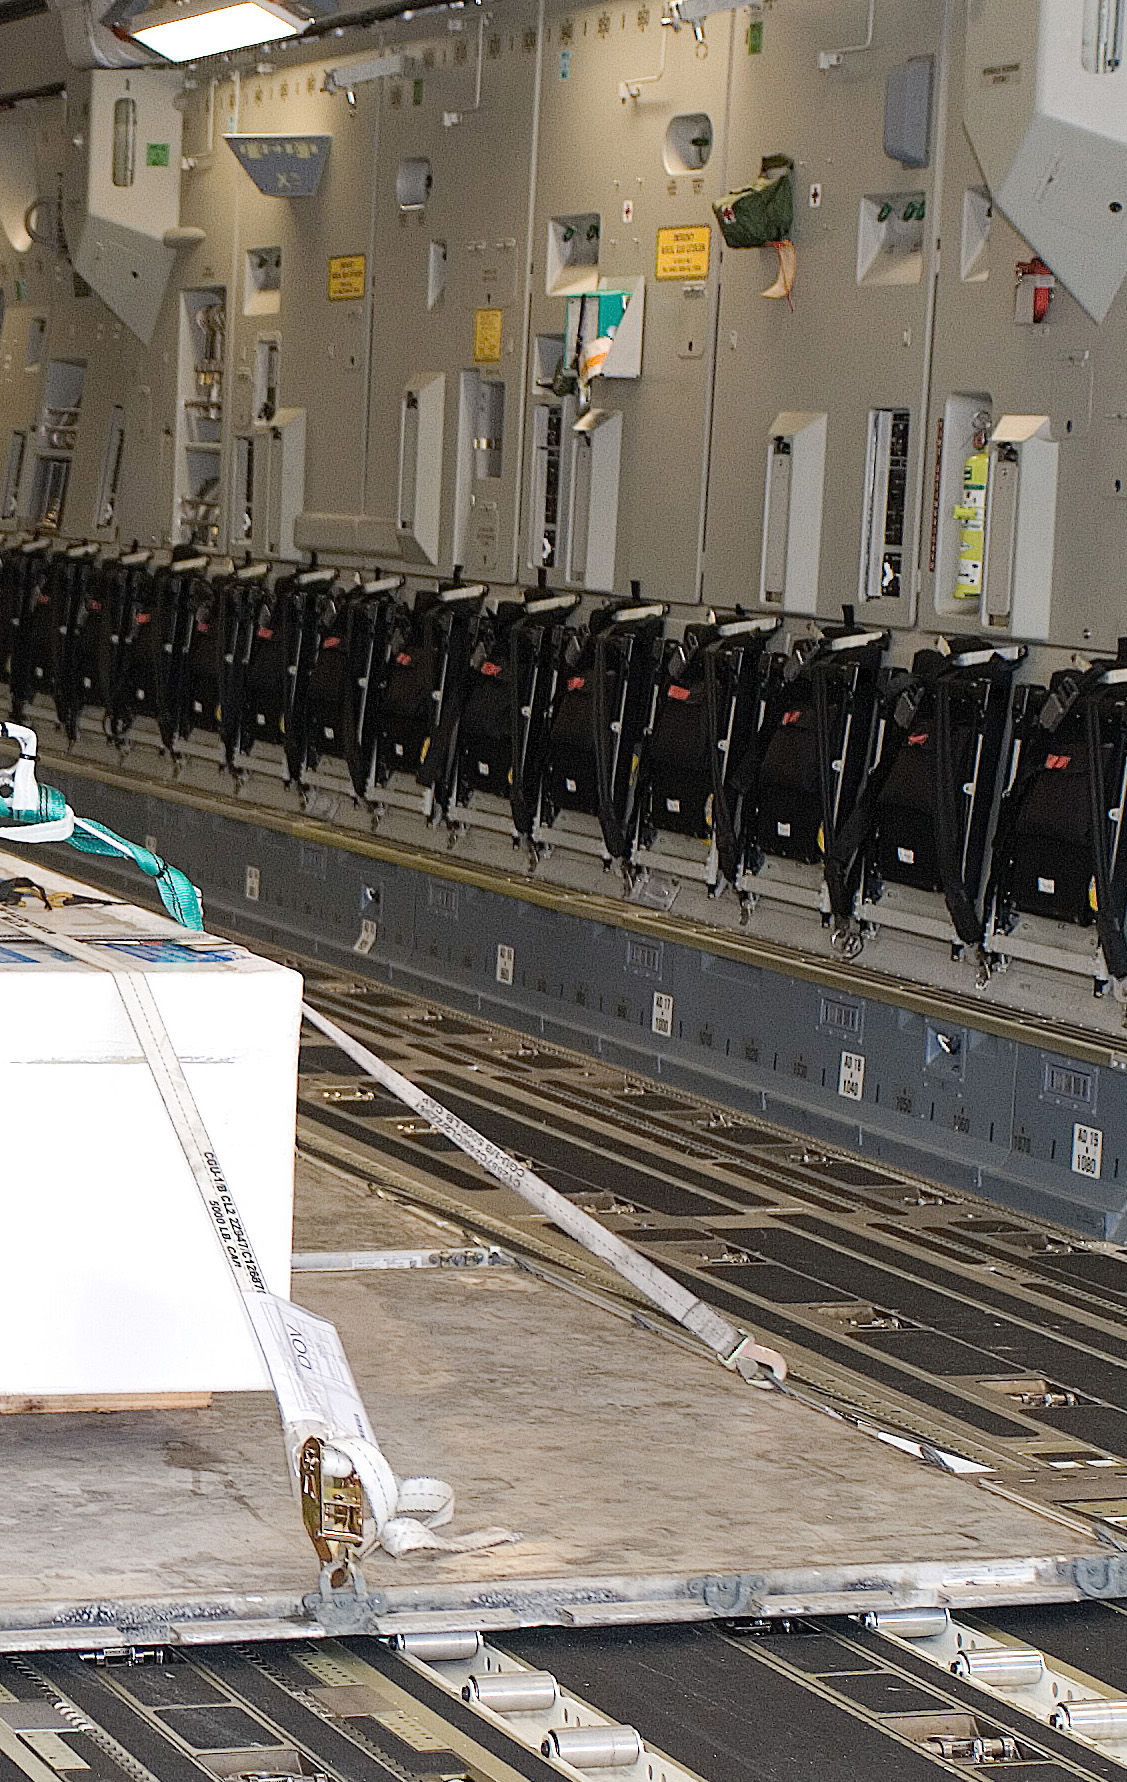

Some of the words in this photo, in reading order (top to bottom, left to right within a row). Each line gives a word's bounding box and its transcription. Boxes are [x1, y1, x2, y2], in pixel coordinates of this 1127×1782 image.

[665, 997, 671, 1010] 17
[843, 1078, 859, 1097] 1040
[1076, 1126, 1087, 1144] AD
[1076, 1153, 1097, 1175] 1080
[203, 1151, 228, 1193] CGU-1/B
[220, 1194, 237, 1216] CL2
[208, 1200, 226, 1225] 5000
[286, 1323, 313, 1371] DOV
